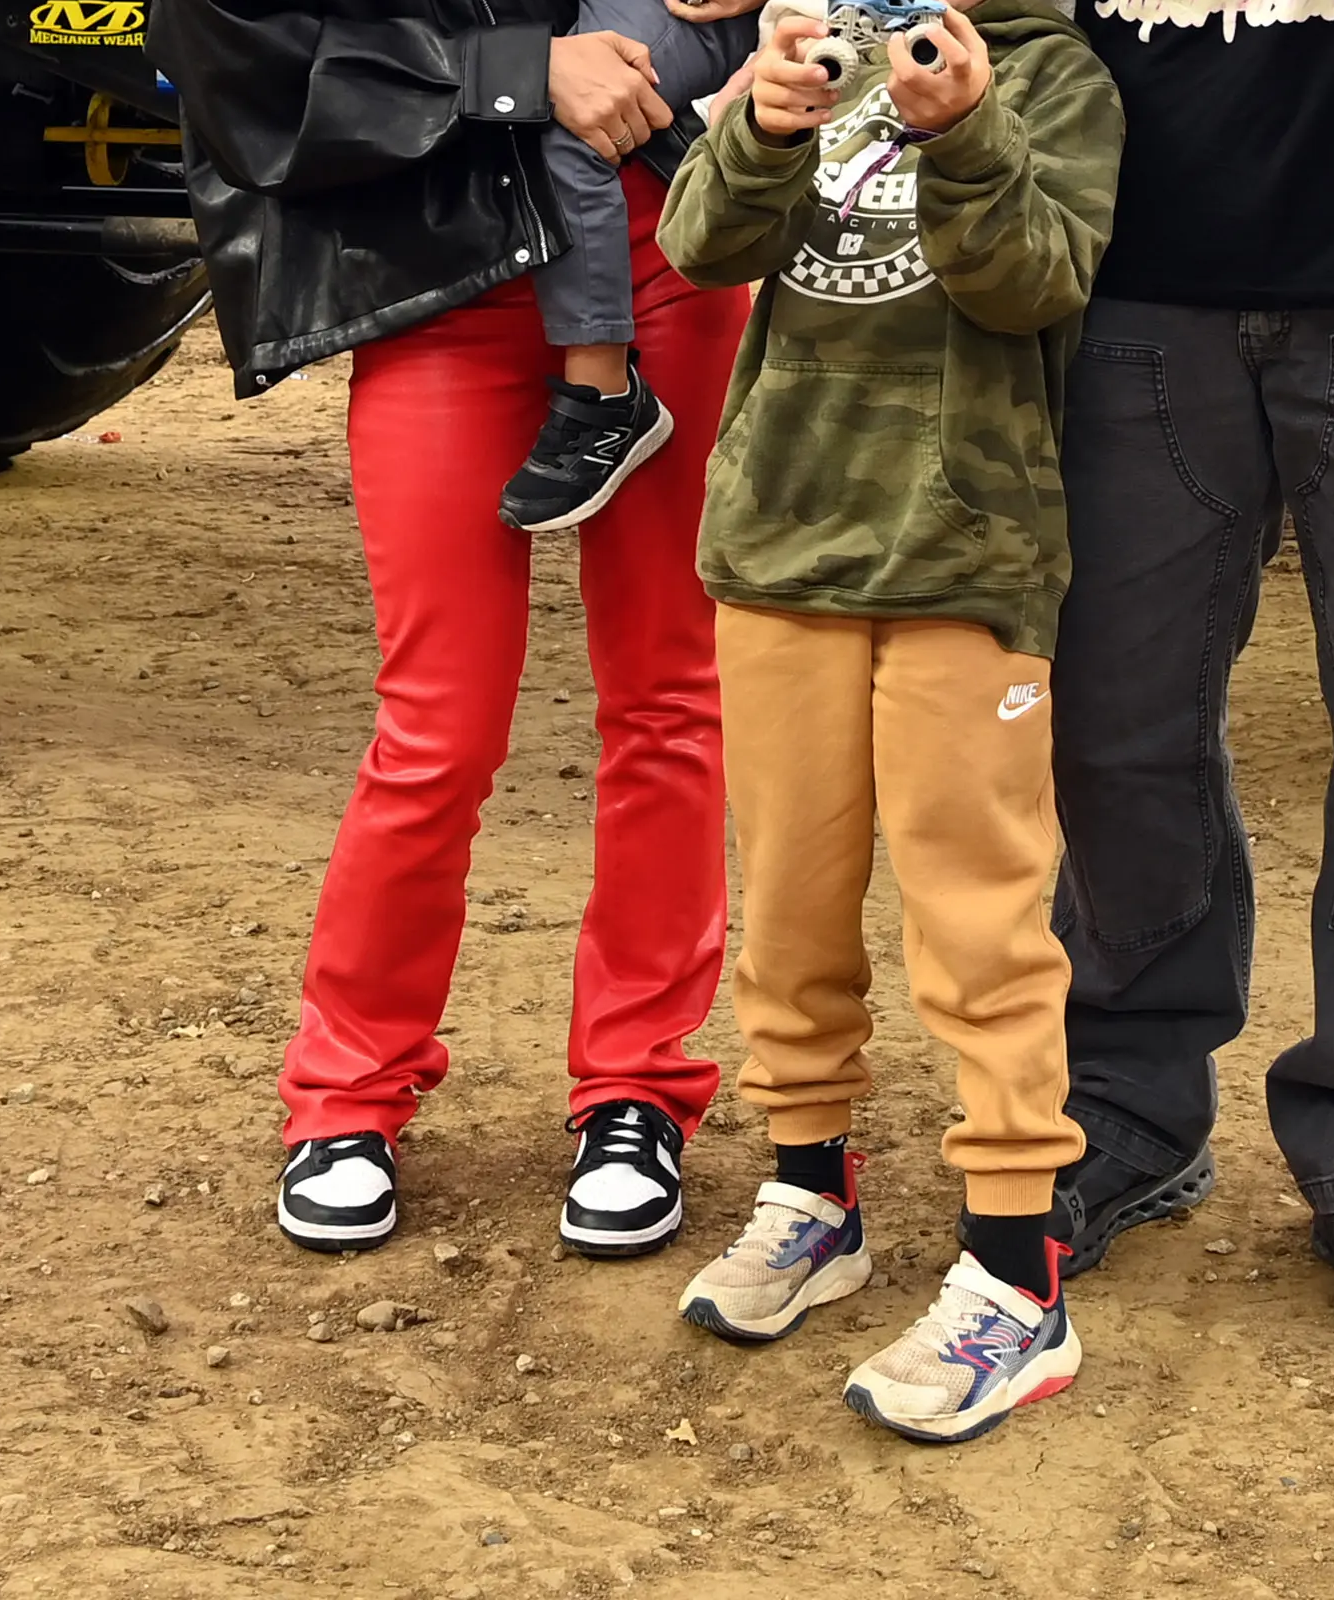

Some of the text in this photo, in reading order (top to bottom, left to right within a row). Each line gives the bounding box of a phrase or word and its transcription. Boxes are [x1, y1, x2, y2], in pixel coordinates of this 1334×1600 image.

[30, 28, 145, 47] MECHANIX WEAR
[827, 213, 917, 231] ACING
[1006, 682, 1040, 705] NIKE
